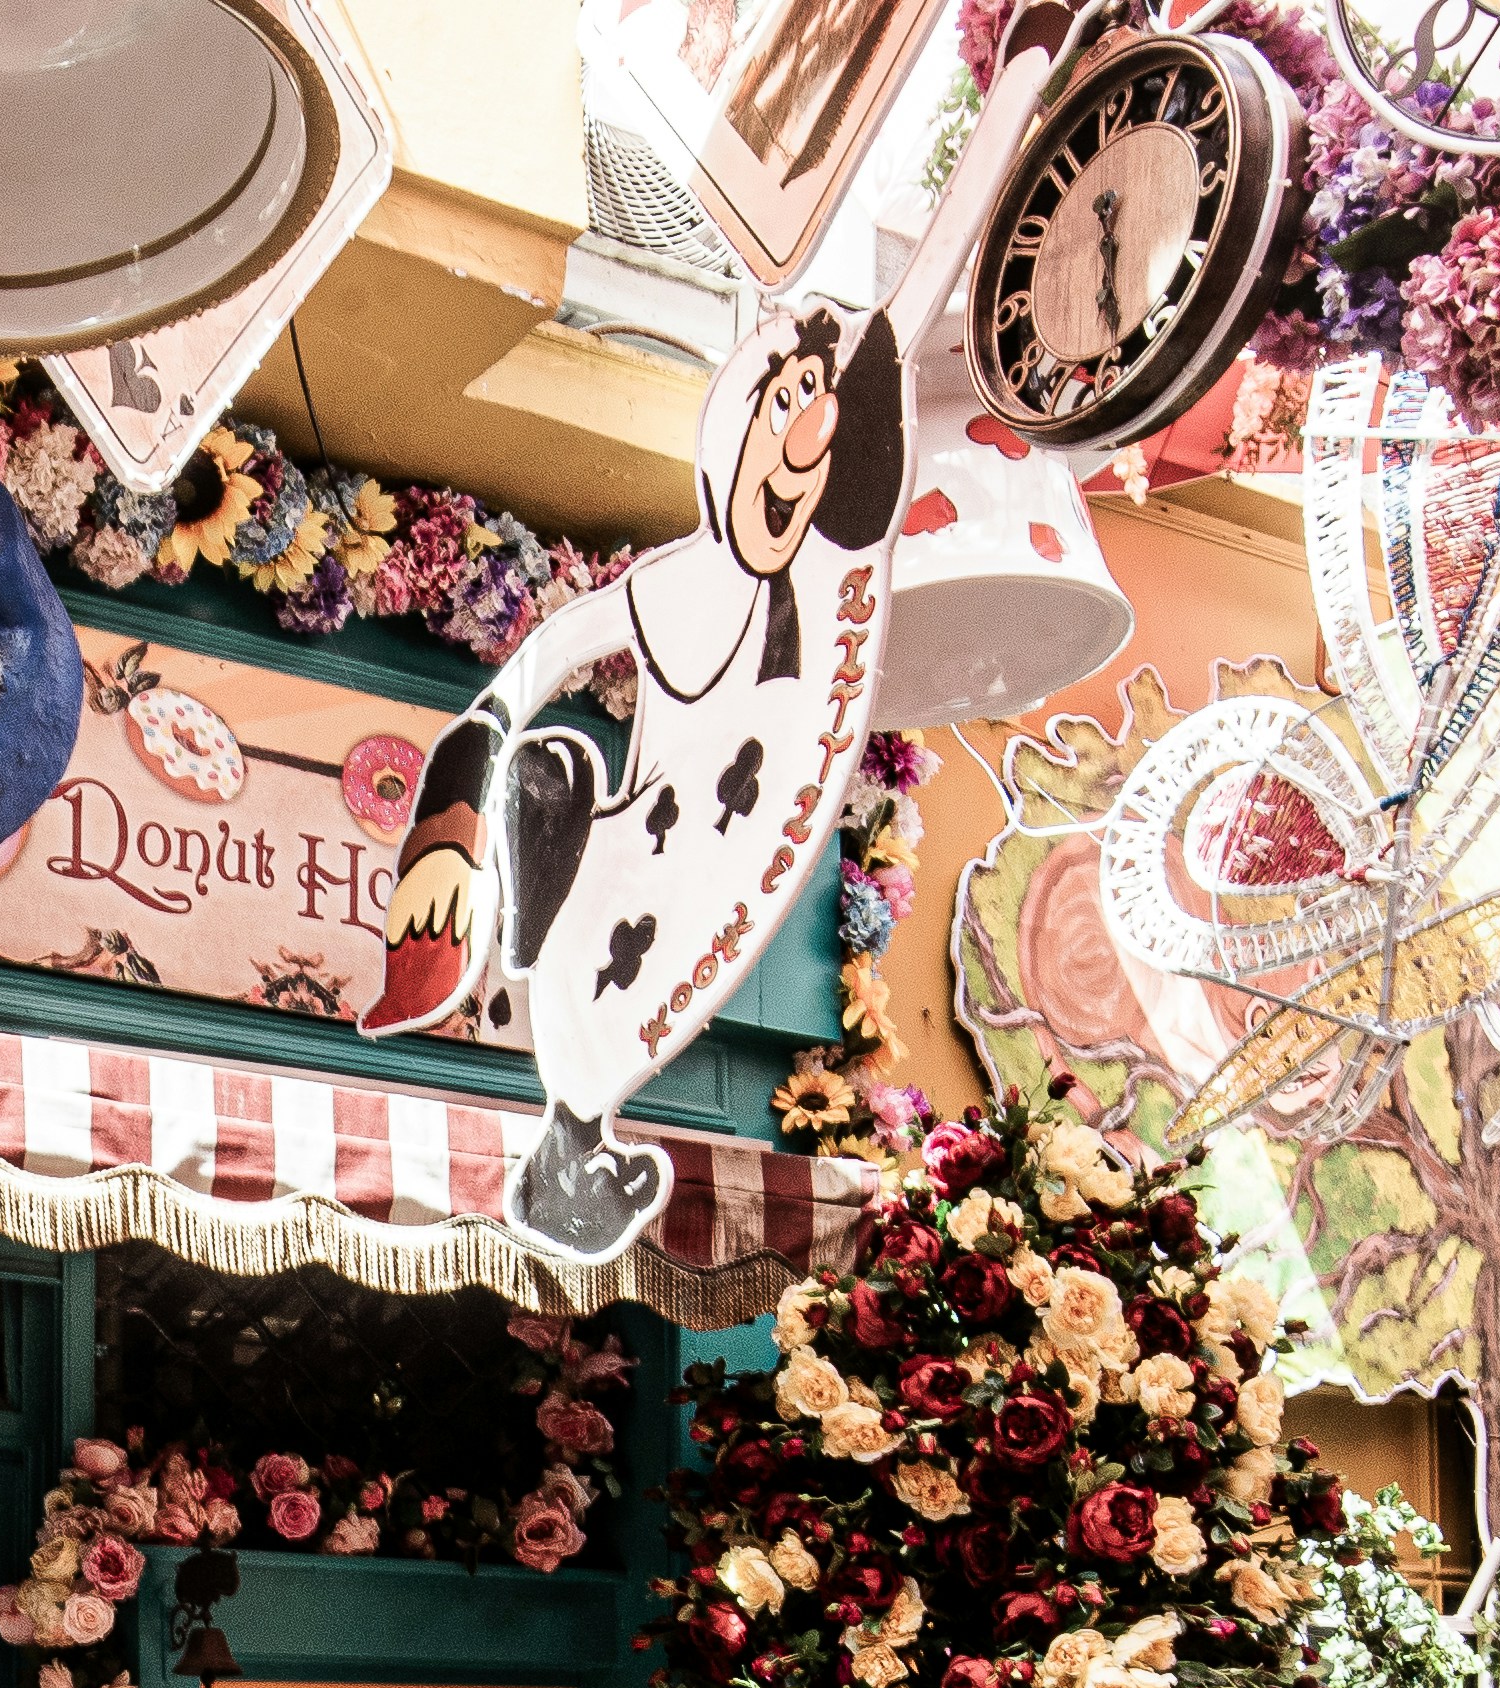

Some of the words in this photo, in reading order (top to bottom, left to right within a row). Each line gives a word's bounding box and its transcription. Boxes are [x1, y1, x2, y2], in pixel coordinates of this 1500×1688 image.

[161, 409, 184, 441] A
[46, 777, 275, 915] Donut
[639, 901, 755, 1058] KOOK
